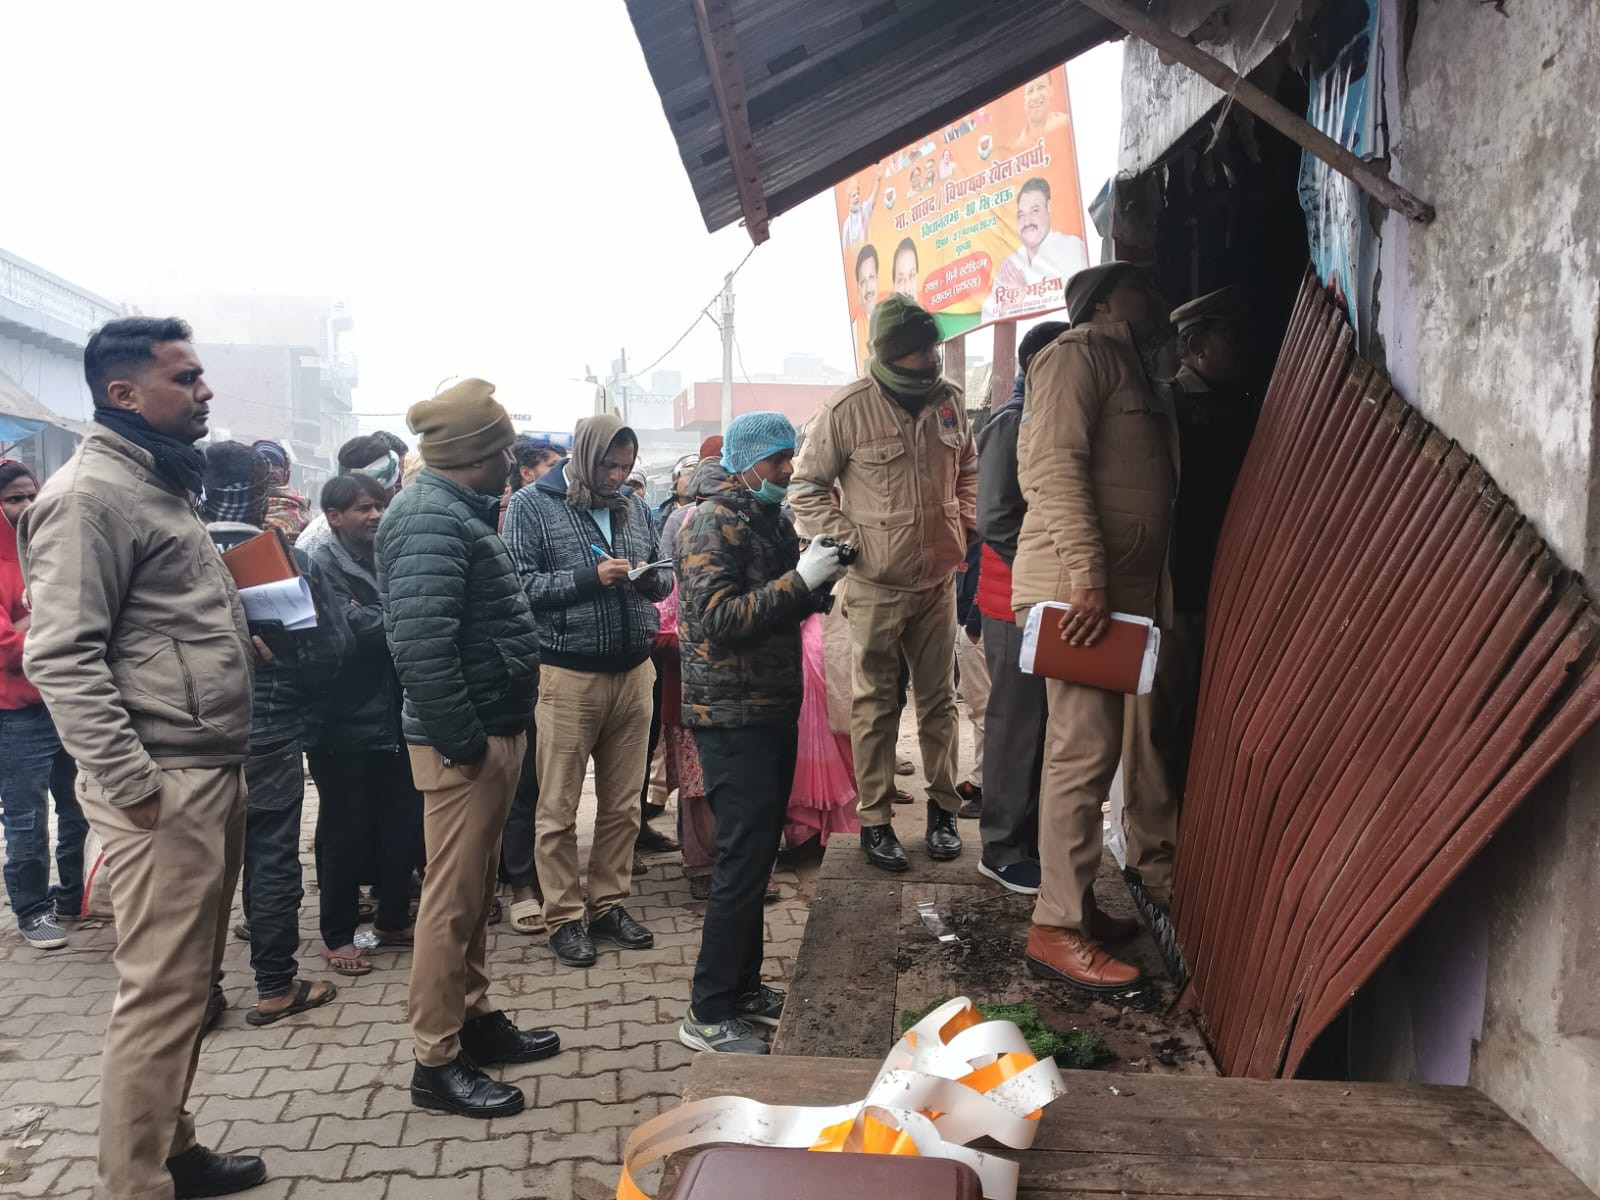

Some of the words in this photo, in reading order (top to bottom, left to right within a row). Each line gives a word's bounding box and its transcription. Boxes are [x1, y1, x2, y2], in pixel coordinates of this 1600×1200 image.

[895, 211, 909, 229] मा.
[911, 197, 935, 221] सांसद
[945, 171, 986, 203] विधायक
[989, 160, 1012, 184] खेल
[995, 286, 1020, 304] रिंकू
[1024, 276, 1063, 297] भईया
